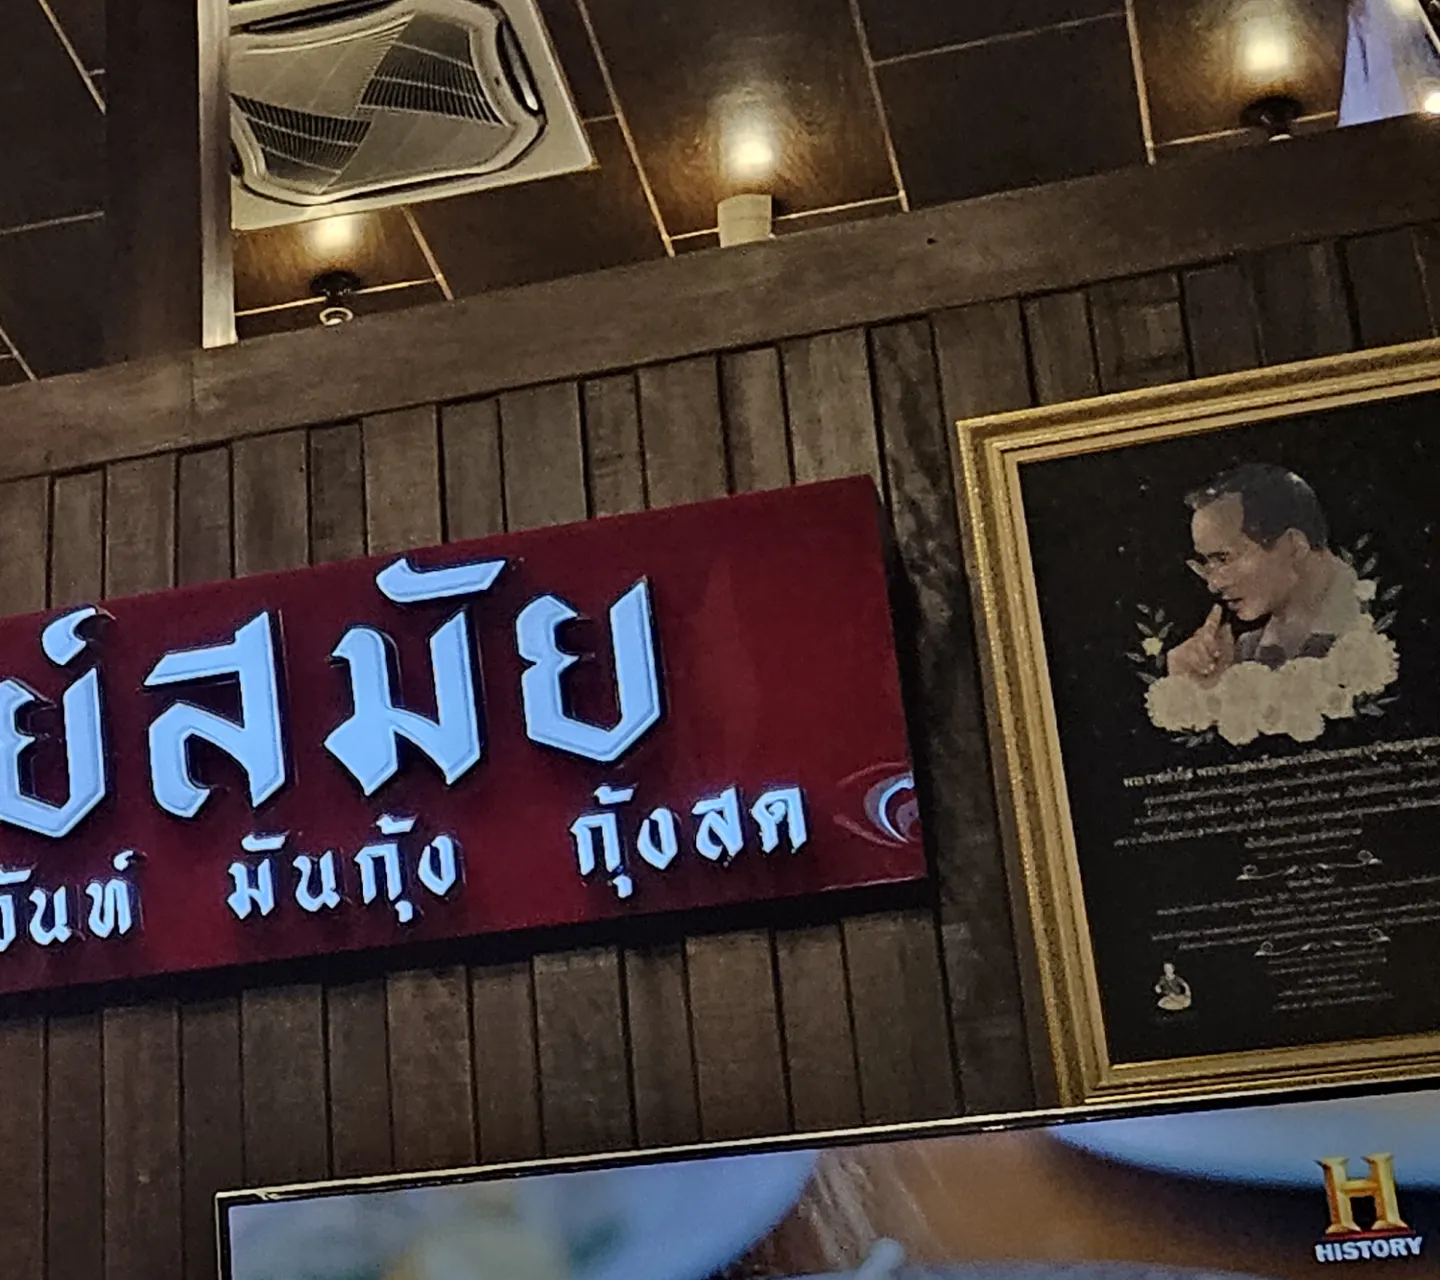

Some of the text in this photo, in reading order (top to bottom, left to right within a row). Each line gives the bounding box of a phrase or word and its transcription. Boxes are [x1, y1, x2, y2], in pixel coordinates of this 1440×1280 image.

[226, 815, 459, 923] มันกุ้ง
[569, 783, 808, 899] กุ้งสด
[1313, 1152, 1409, 1235] H
[1314, 1236, 1423, 1263] HISTORY
